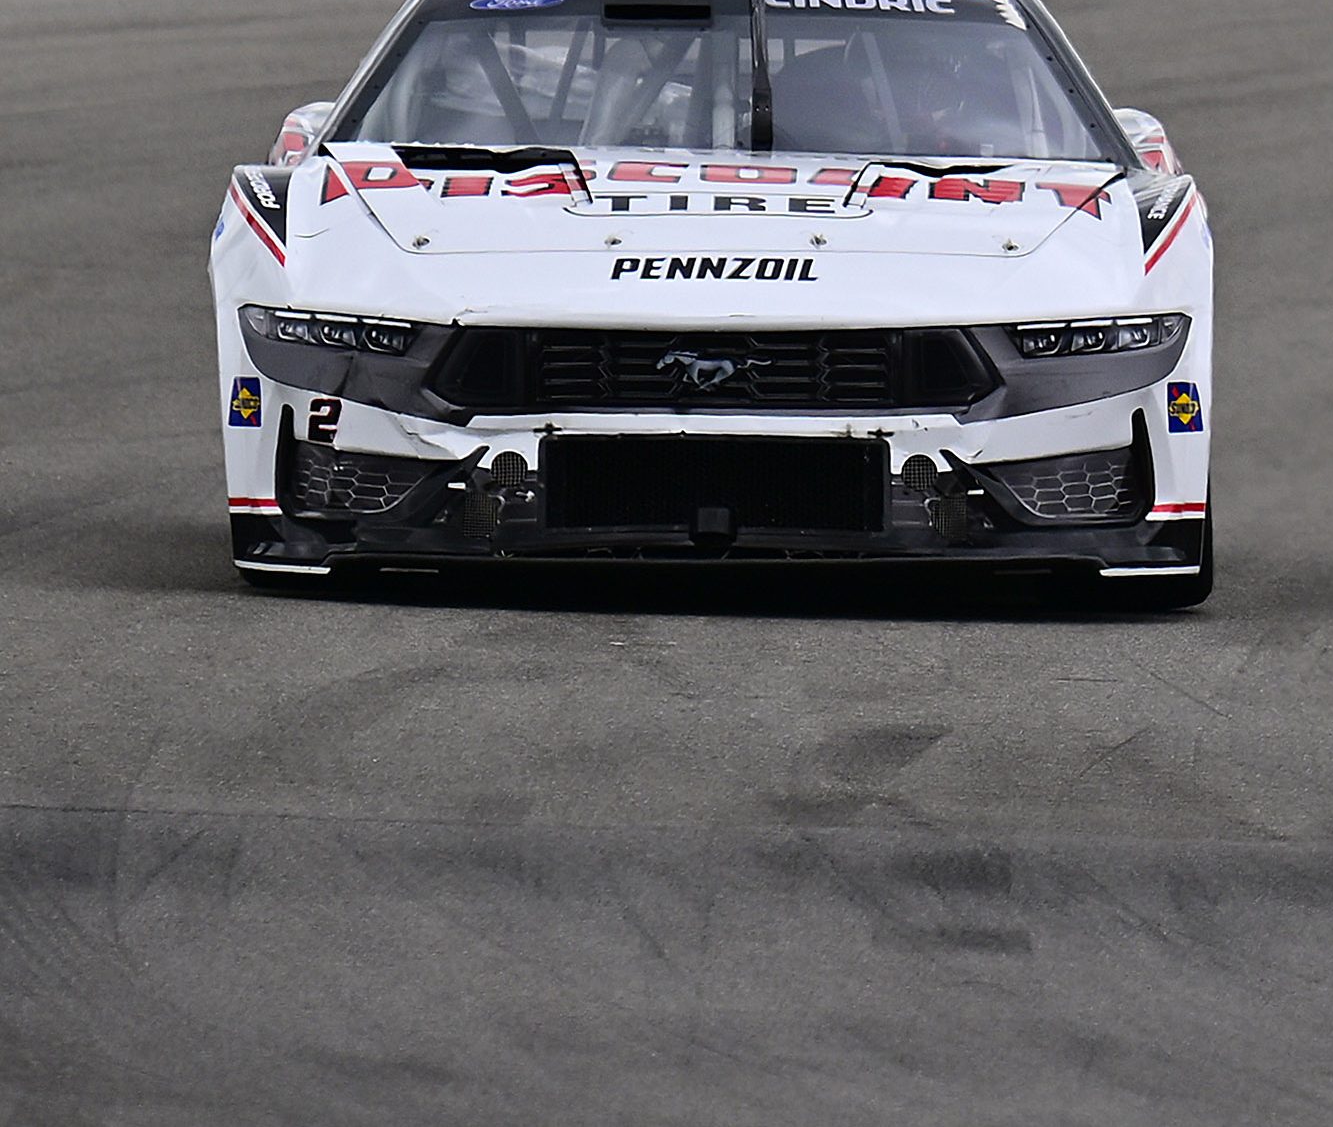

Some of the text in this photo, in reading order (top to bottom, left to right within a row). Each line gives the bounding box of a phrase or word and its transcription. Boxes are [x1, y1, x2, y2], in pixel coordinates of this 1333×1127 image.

[320, 160, 1112, 220] DISCOUNT
[595, 195, 837, 213] TIRE
[610, 257, 819, 281] PENNZOIL
[307, 398, 342, 444] 2
